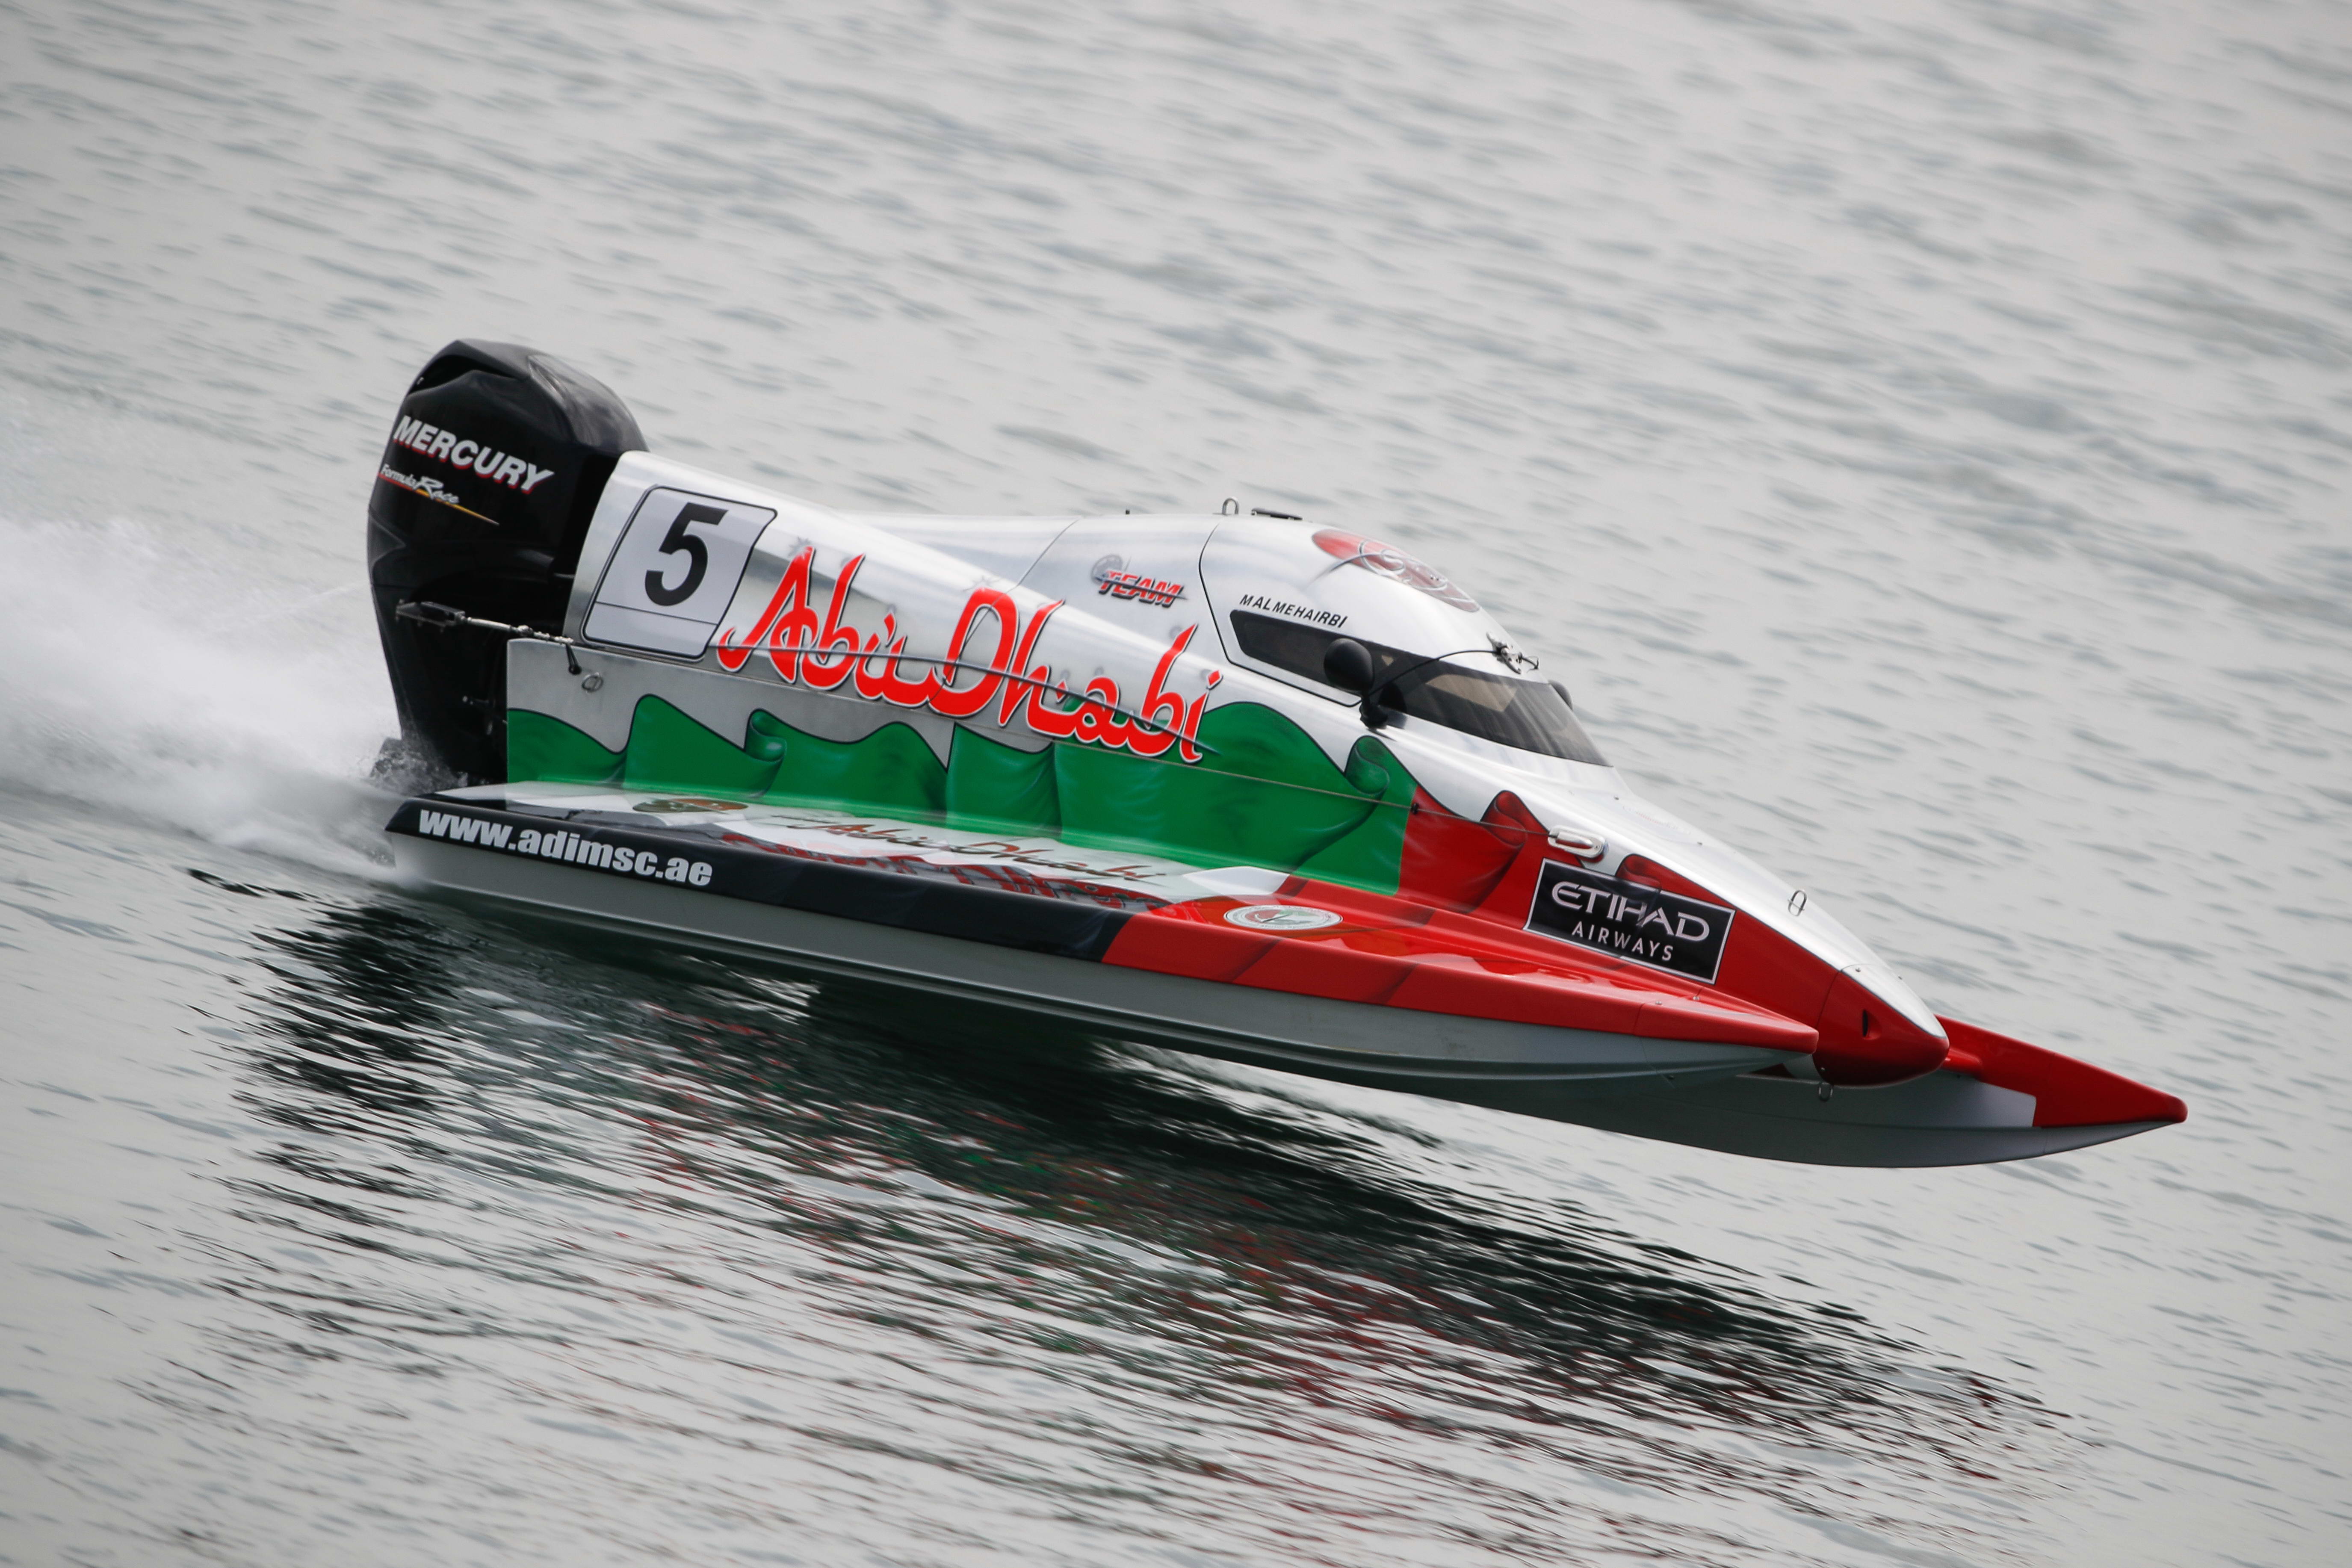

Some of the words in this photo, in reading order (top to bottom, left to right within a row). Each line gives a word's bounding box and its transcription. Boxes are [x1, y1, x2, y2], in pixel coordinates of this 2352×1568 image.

[393, 415, 554, 494] MERCURY
[645, 502, 729, 606] 5
[1098, 569, 1184, 608] TEAM
[419, 809, 712, 886] www.adimsc.ae
[1551, 881, 1710, 942] ETIHAD
[1572, 921, 1674, 961] AIRWAYS
